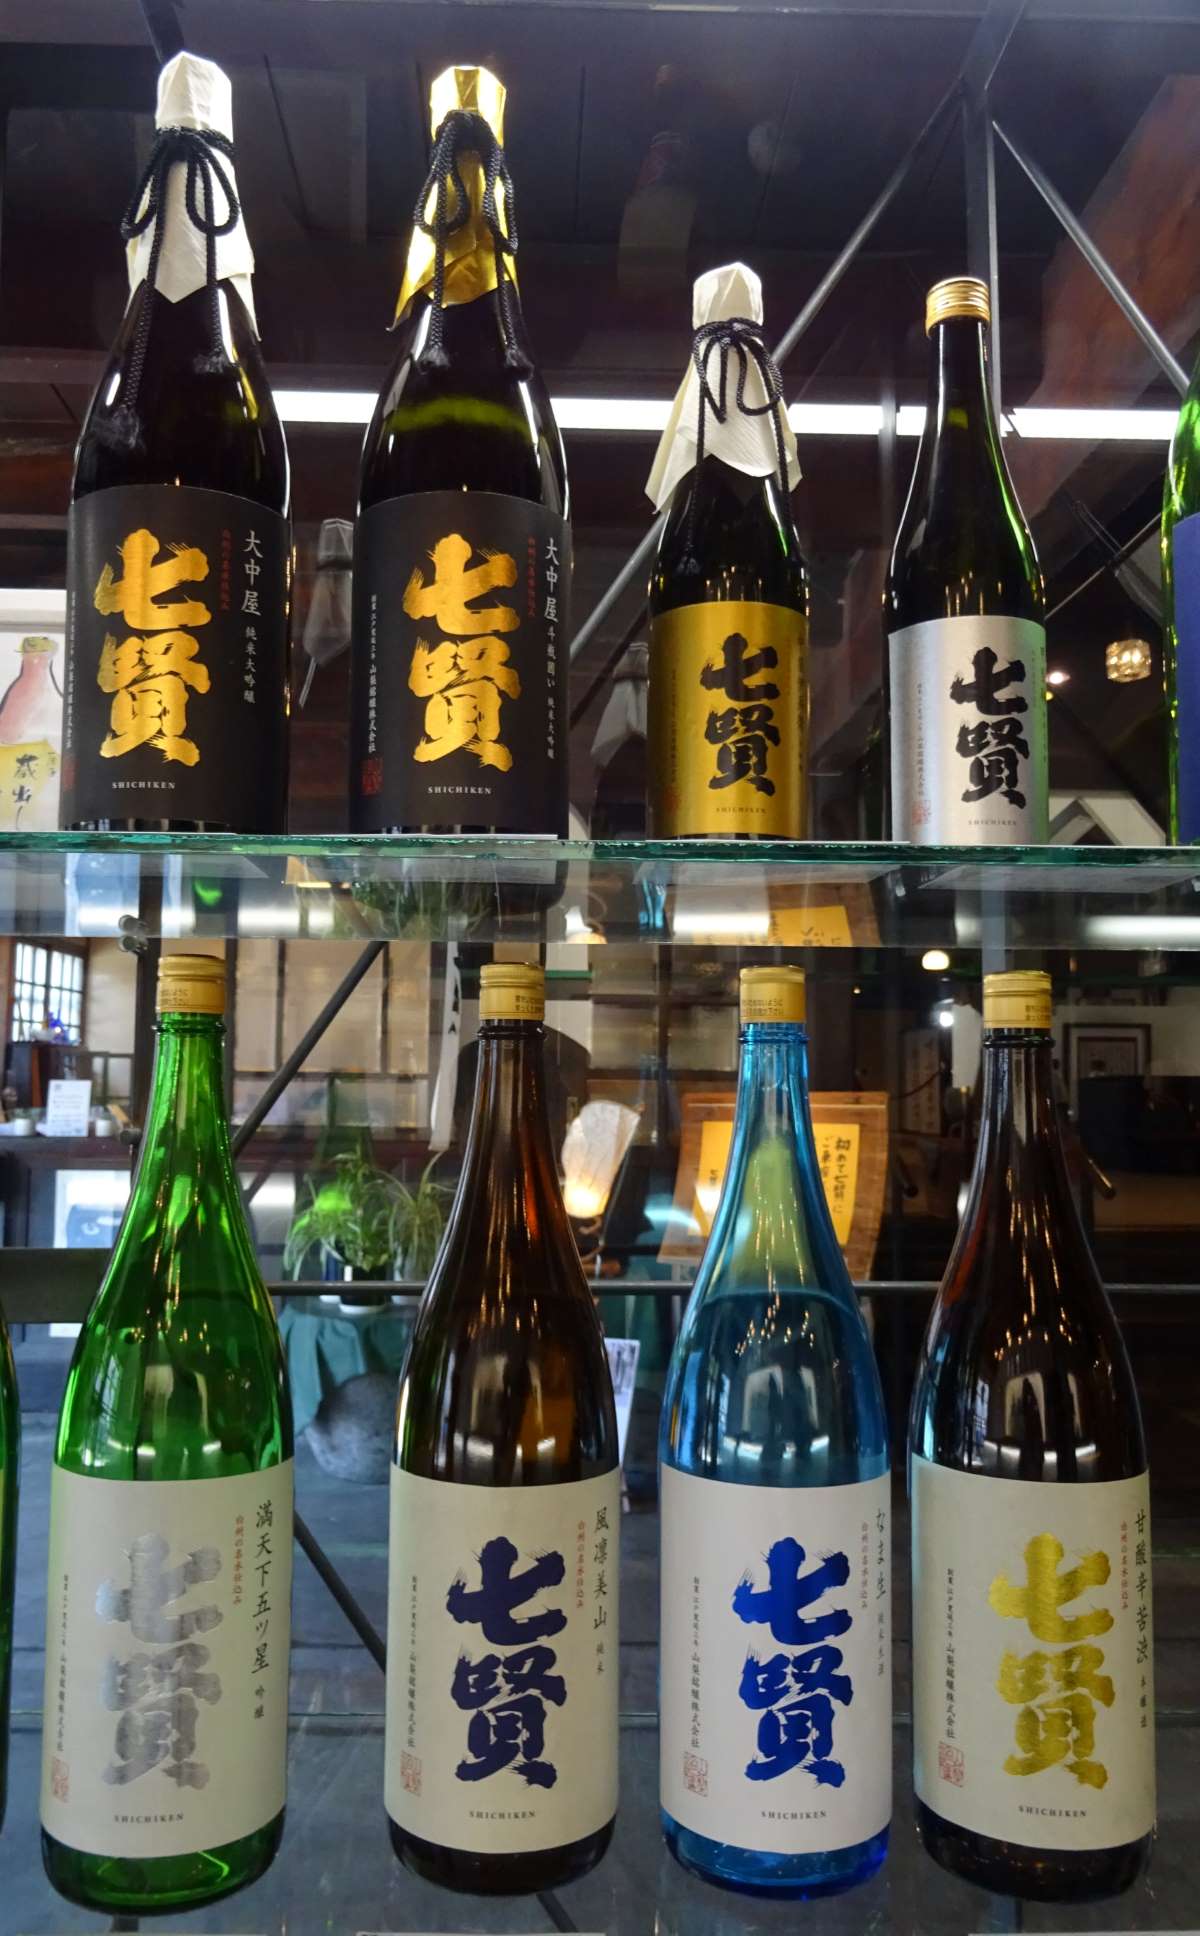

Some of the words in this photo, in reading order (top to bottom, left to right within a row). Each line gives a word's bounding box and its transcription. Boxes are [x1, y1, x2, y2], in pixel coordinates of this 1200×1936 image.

[240, 530, 263, 617] 大中屋
[544, 537, 561, 623] 大中屋
[94, 528, 211, 767] 七賢
[402, 533, 522, 772] 七賢
[701, 633, 781, 796] 七賢
[950, 647, 1029, 809] 七賢
[112, 781, 176, 790] SHICHIKEN
[428, 786, 492, 795] SHICHIKEN
[95, 1533, 223, 1789] 七賢
[446, 1536, 567, 1789] 七賢
[733, 1537, 853, 1788] 七賢
[988, 1532, 1115, 1789] 七賢
[114, 1813, 184, 1823] SHICHIKEN
[469, 1810, 536, 1819] SHICHIKEN
[761, 1810, 827, 1819] SHICHIKEN
[1018, 1806, 1087, 1817] SHICHIKEN
